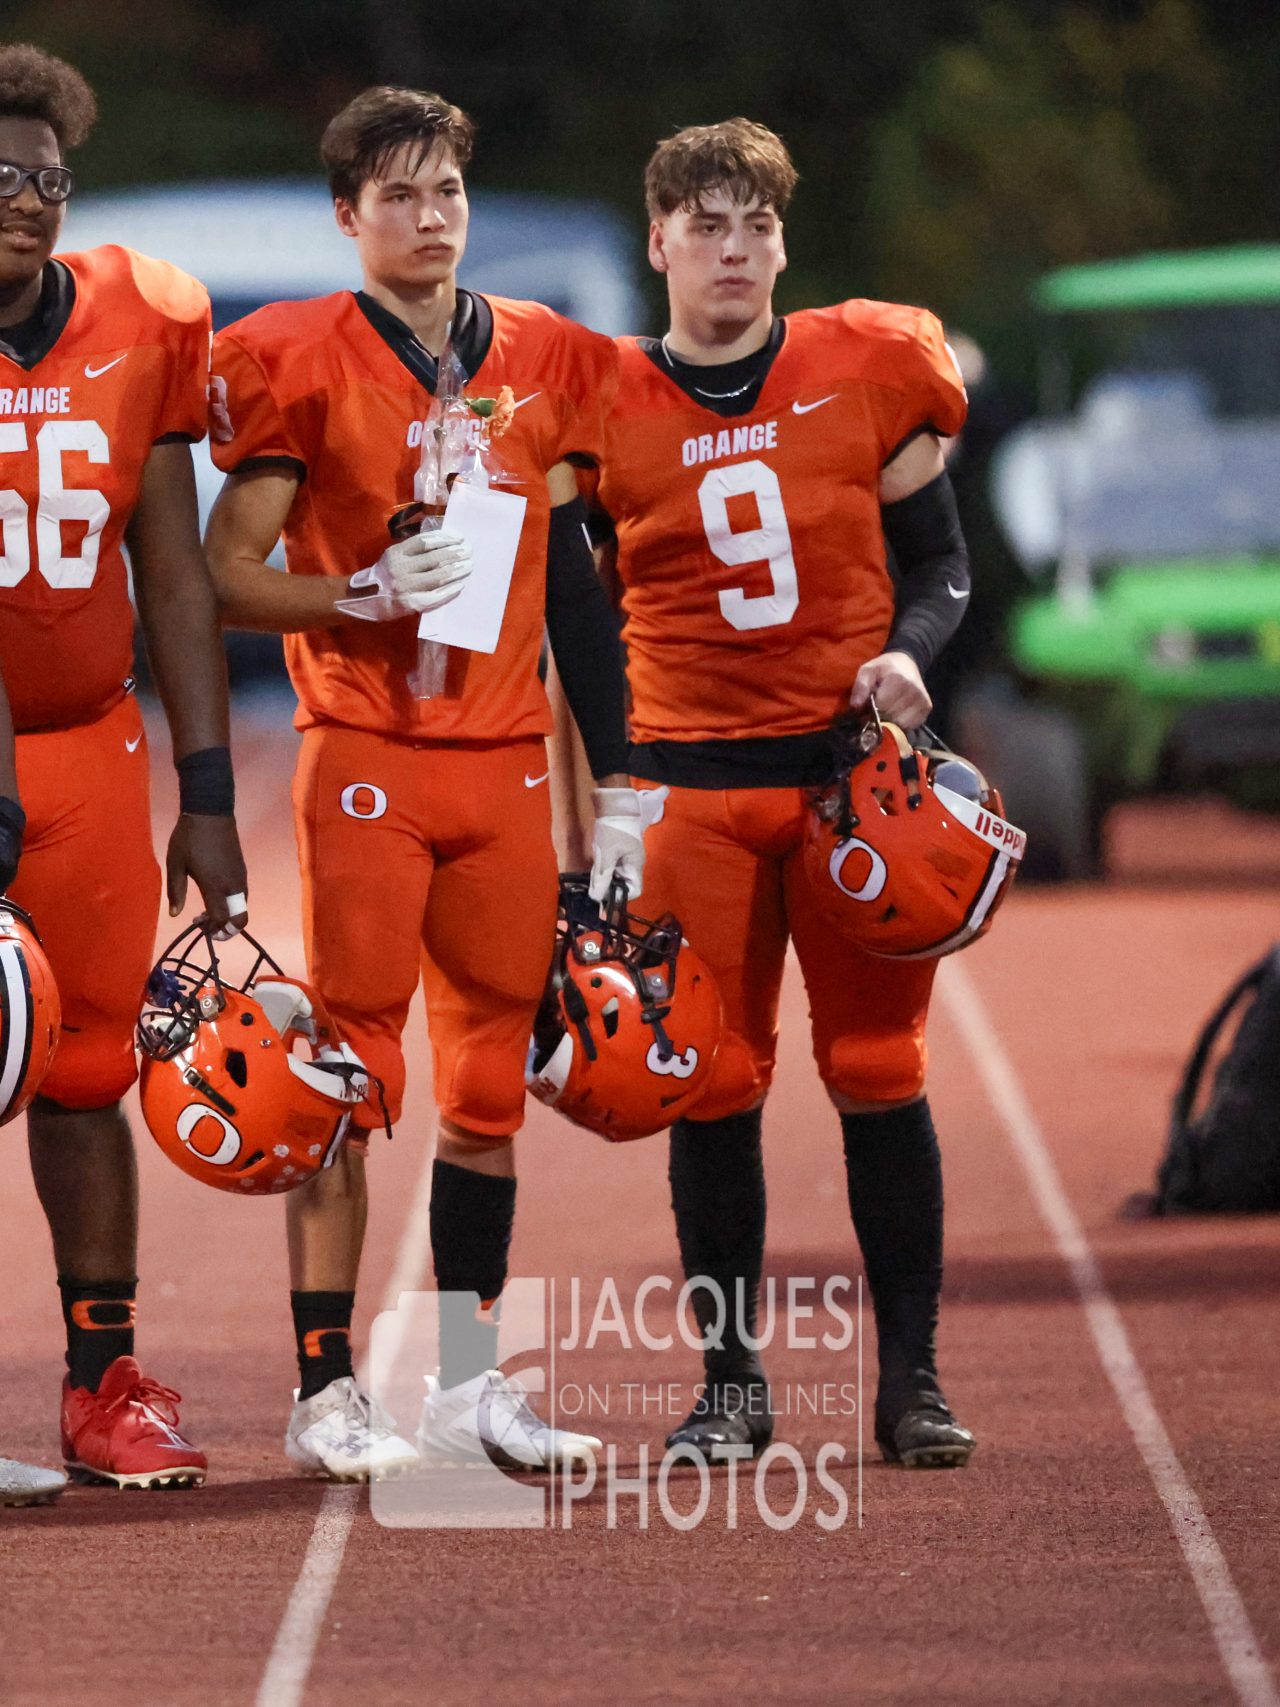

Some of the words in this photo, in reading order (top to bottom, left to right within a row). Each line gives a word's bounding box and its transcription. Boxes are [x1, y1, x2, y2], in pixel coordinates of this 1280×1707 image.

[682, 420, 778, 467] ORANGE
[697, 459, 800, 631] 9
[974, 811, 1027, 851] ddell
